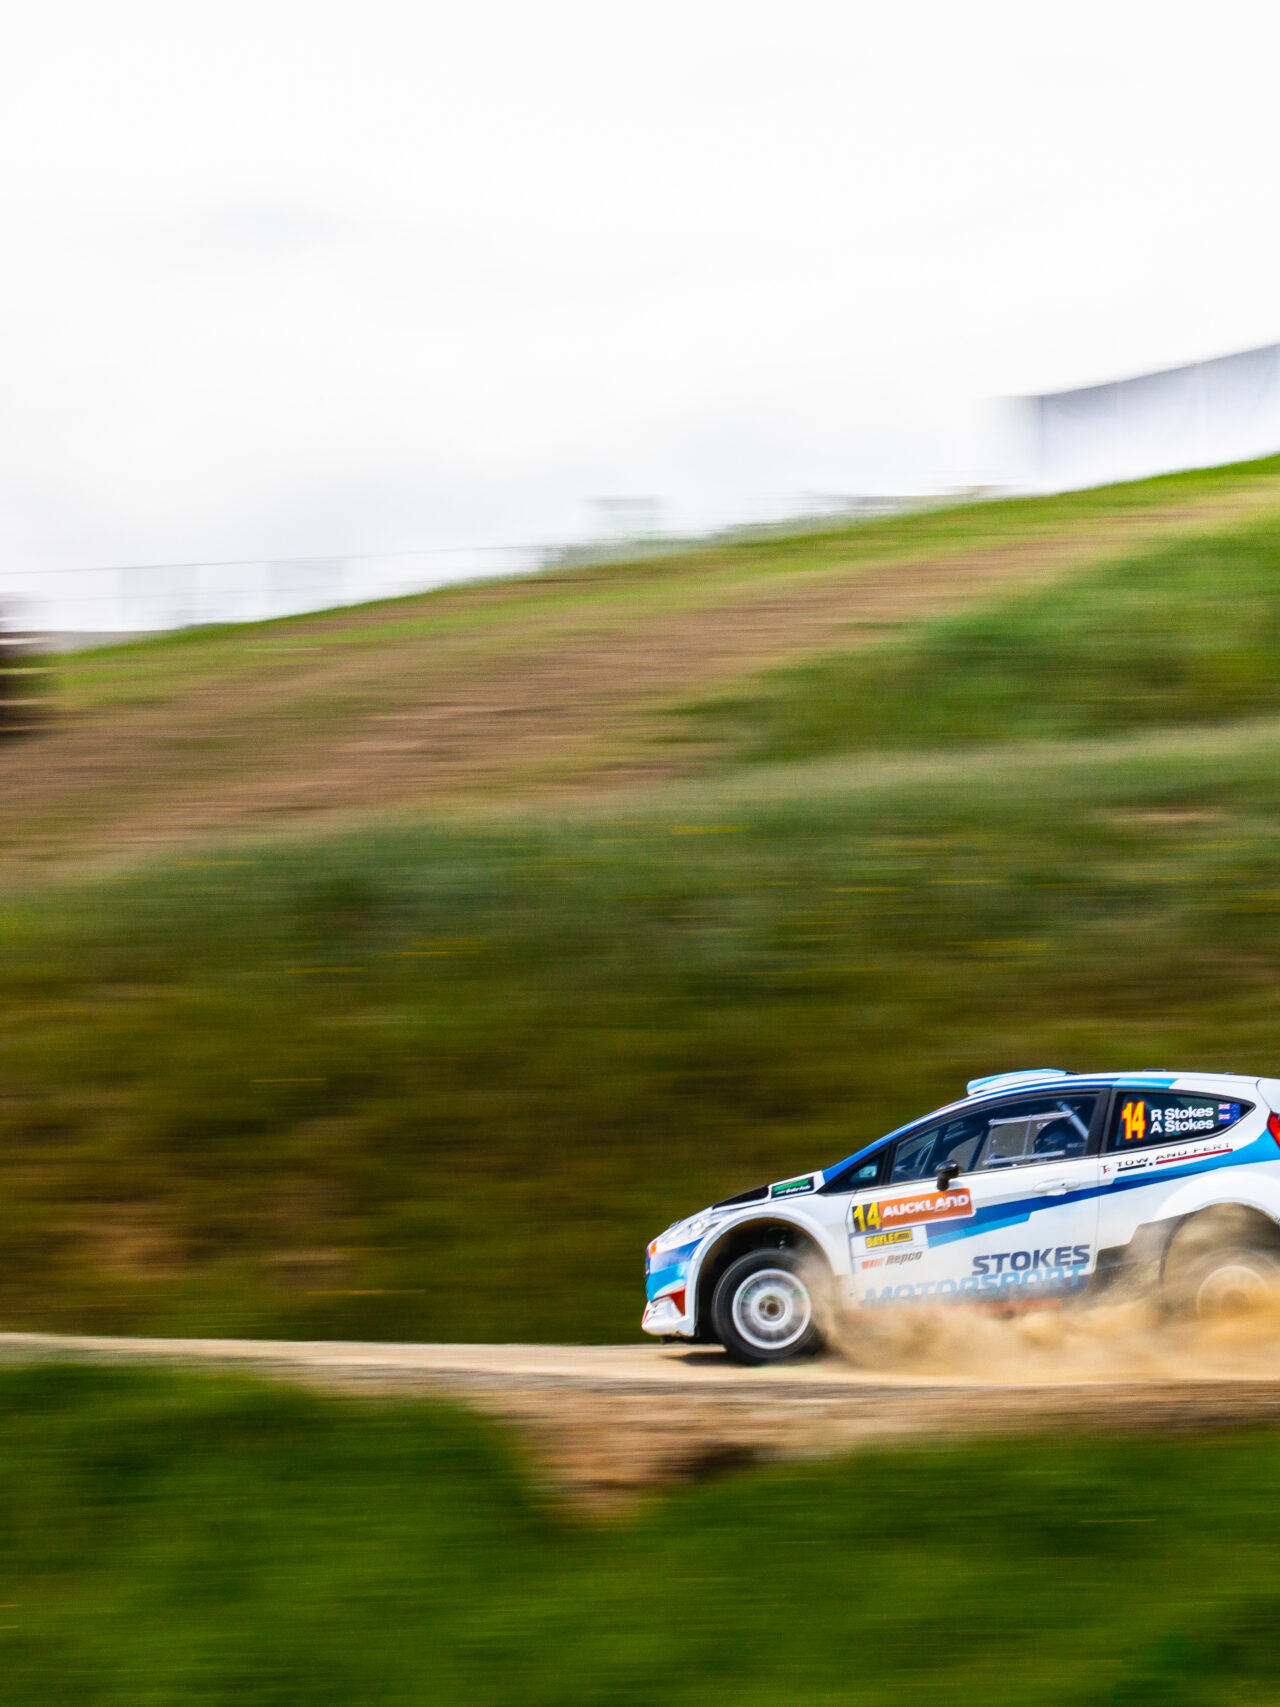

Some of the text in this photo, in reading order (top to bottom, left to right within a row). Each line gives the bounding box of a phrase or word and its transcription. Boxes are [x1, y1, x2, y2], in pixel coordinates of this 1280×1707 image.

[1121, 1101, 1146, 1139] 14
[1150, 1106, 1213, 1121] R Stokes
[1150, 1118, 1214, 1134] A Stokes
[854, 1201, 881, 1232] 14
[882, 1194, 969, 1218] AUCKLAND
[885, 1251, 923, 1266] Repco
[972, 1244, 1090, 1275] STOKES
[861, 1264, 1087, 1306] MOTORSPORT
